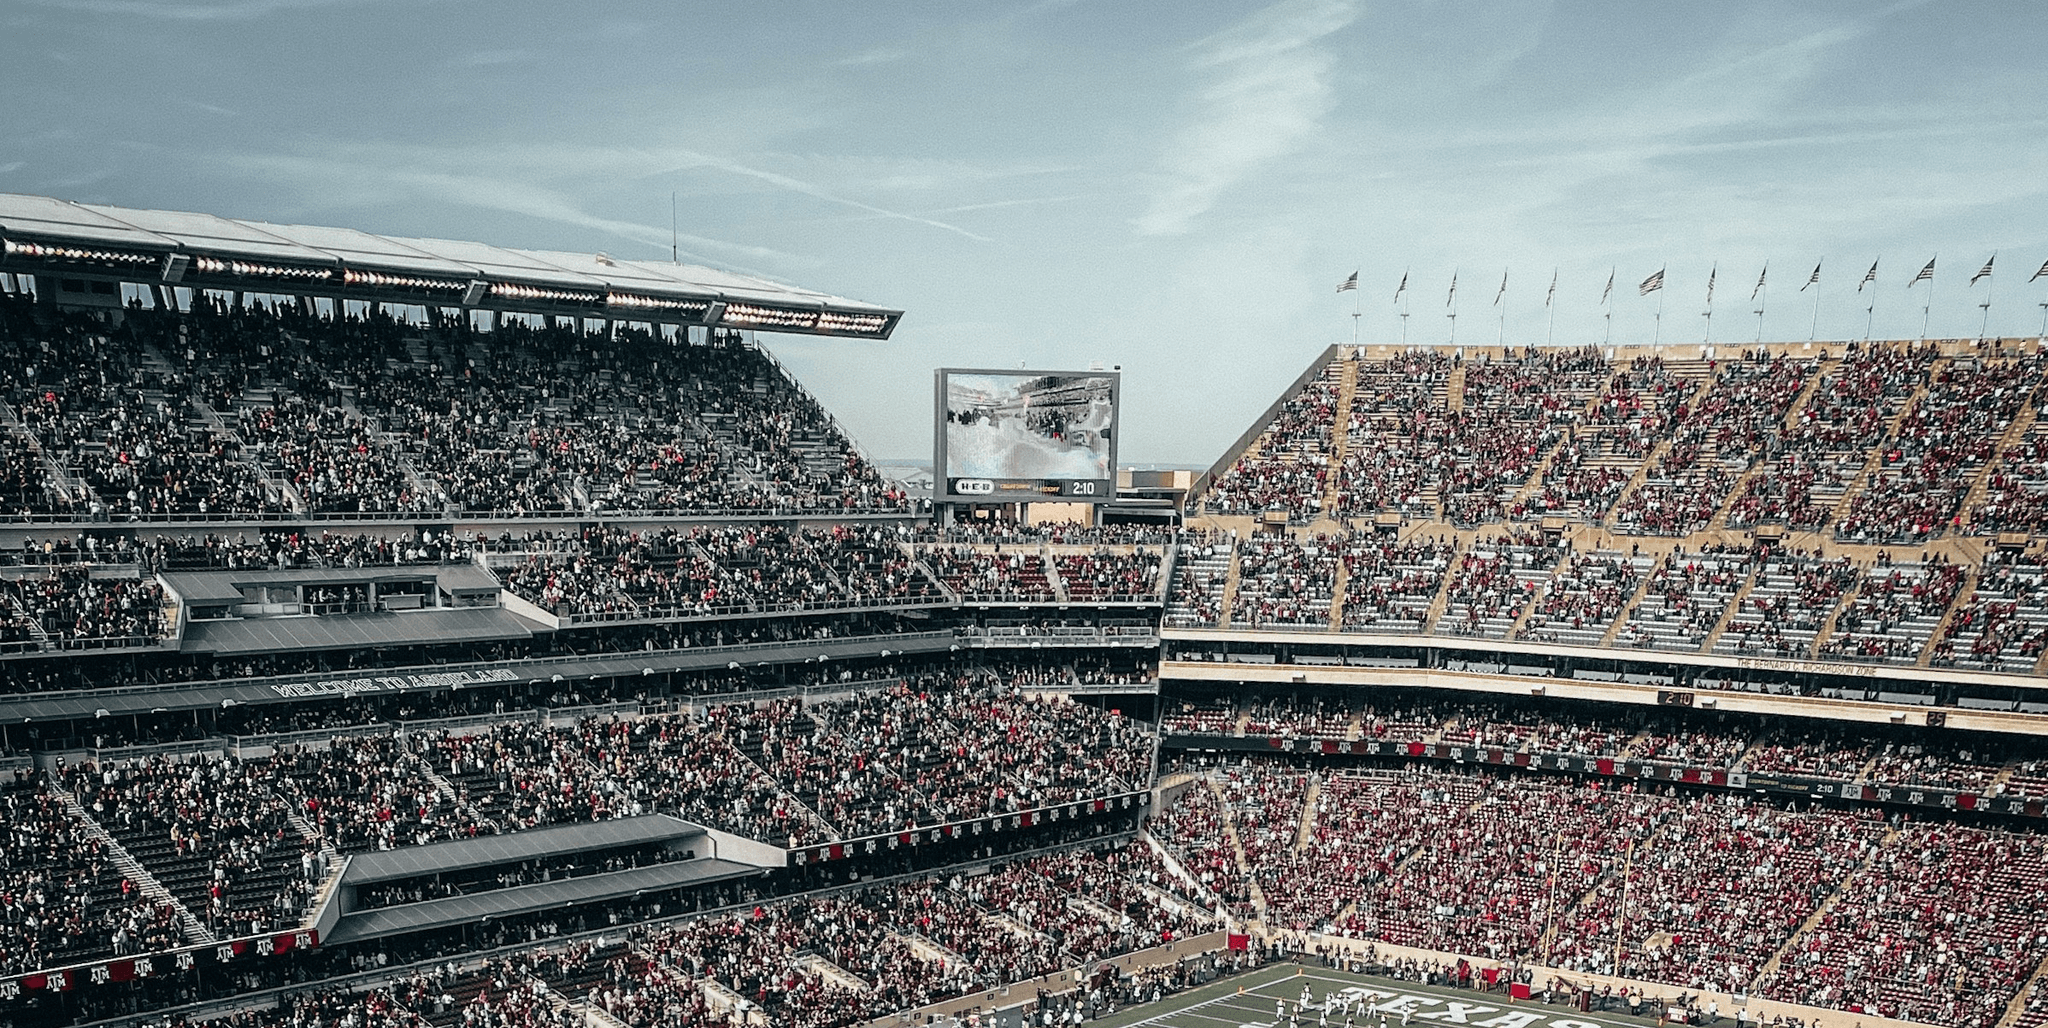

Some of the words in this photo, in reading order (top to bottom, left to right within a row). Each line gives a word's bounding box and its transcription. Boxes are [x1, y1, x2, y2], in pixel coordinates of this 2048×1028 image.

[1073, 482, 1094, 494] 2:10
[1856, 666, 1877, 676] ZONE
[270, 679, 381, 698] WELCOME
[375, 677, 410, 690] TO
